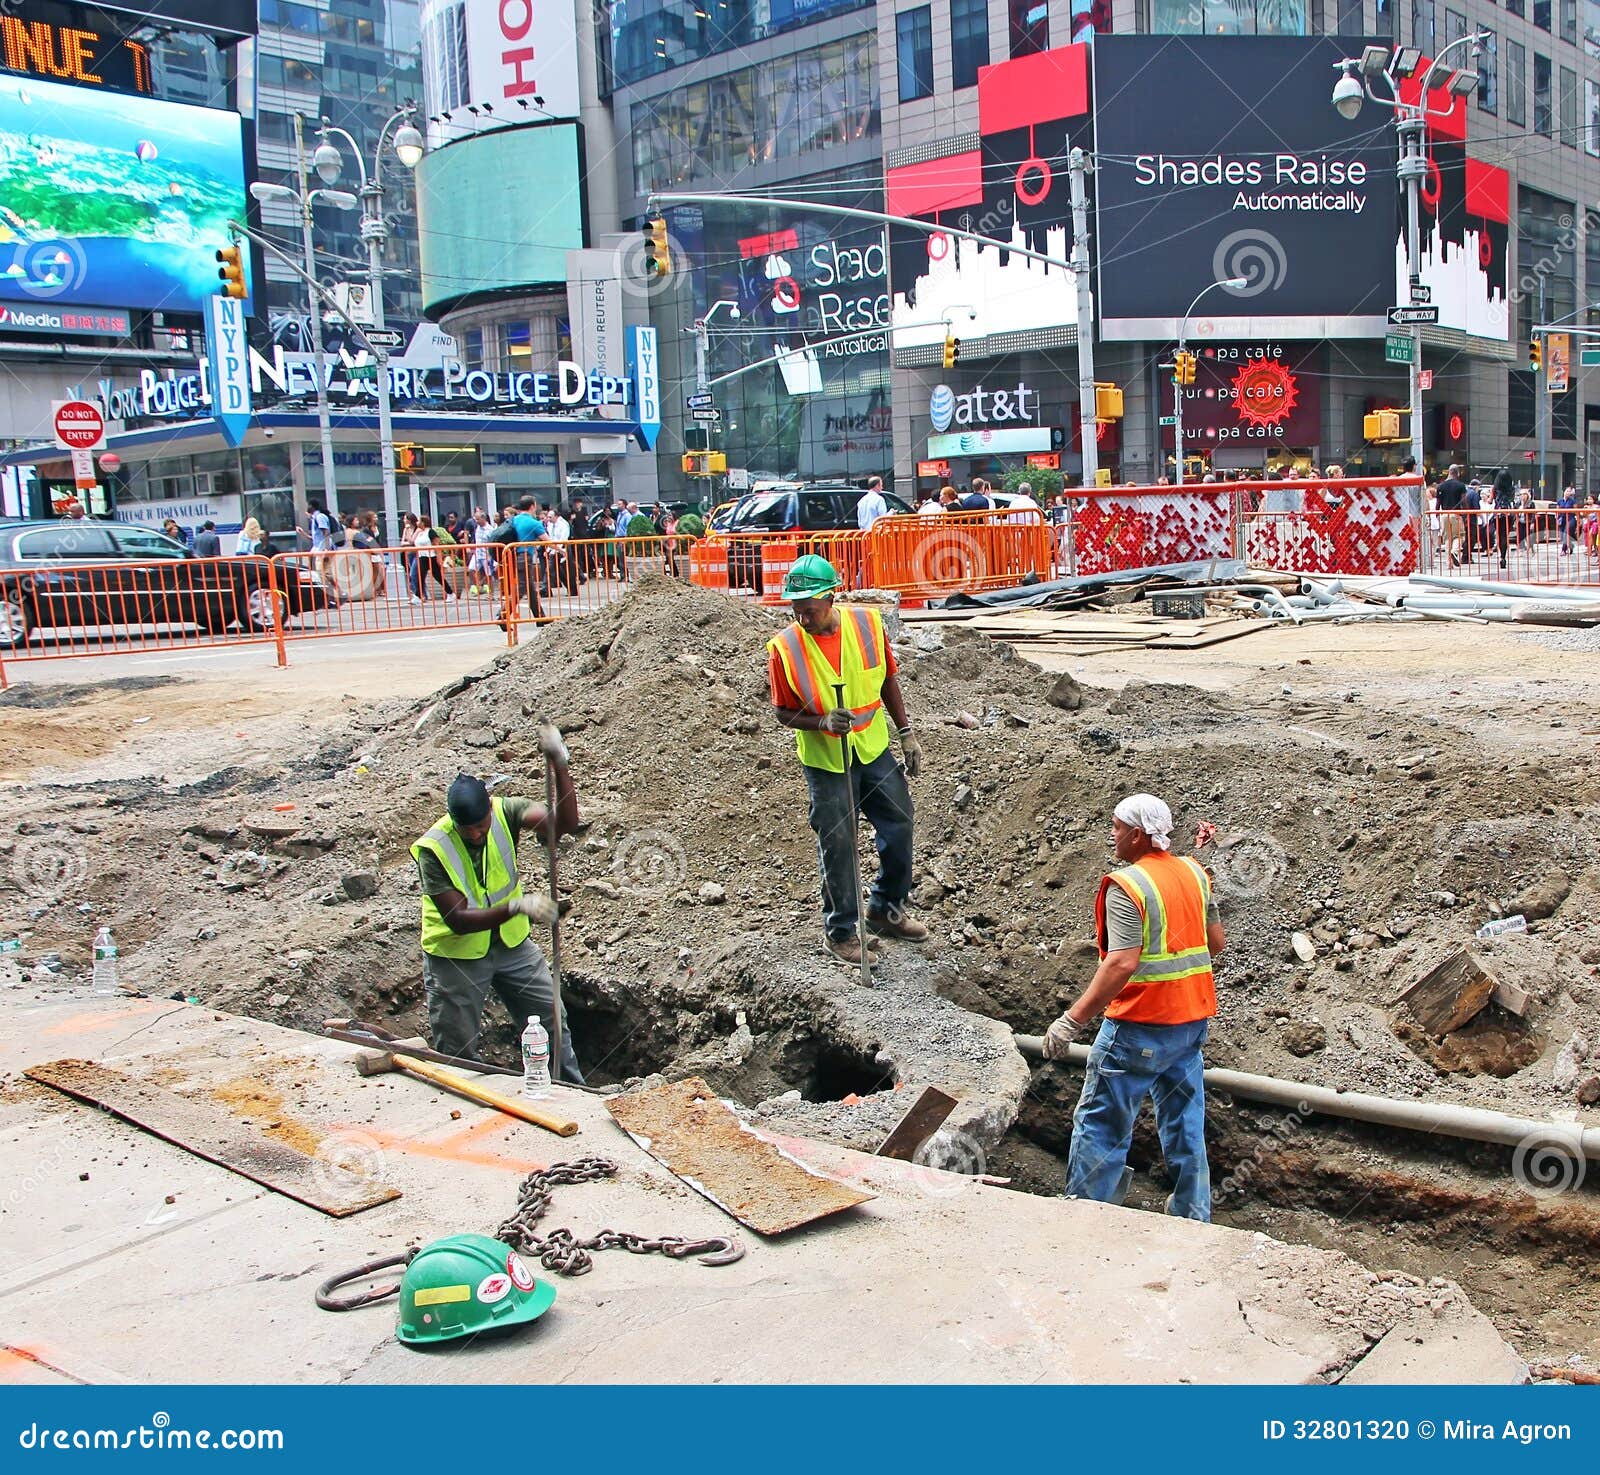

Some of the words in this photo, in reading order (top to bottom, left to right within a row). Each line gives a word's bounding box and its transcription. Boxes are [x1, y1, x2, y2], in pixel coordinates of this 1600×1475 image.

[1135, 154, 1262, 185] Shades
[1275, 154, 1367, 185] Raise
[1232, 191, 1367, 214] Automatically
[595, 280, 606, 333] REUTERS
[11, 311, 60, 328] Media
[1395, 312, 1410, 320] ONE
[1416, 311, 1432, 320] WAY
[432, 336, 452, 346] FIND
[220, 300, 242, 410] NYPD
[1245, 344, 1283, 359] café
[442, 355, 549, 404] POLICE
[558, 360, 632, 405] DEPT
[641, 330, 655, 420] NYPD
[1246, 383, 1284, 398] café
[955, 382, 1033, 425] at&t
[62, 410, 73, 419] DO
[77, 410, 93, 419] NOT
[66, 432, 95, 440] ENTER
[1246, 423, 1284, 438] café
[333, 452, 377, 466] OLICE
[499, 453, 545, 466] POLICE
